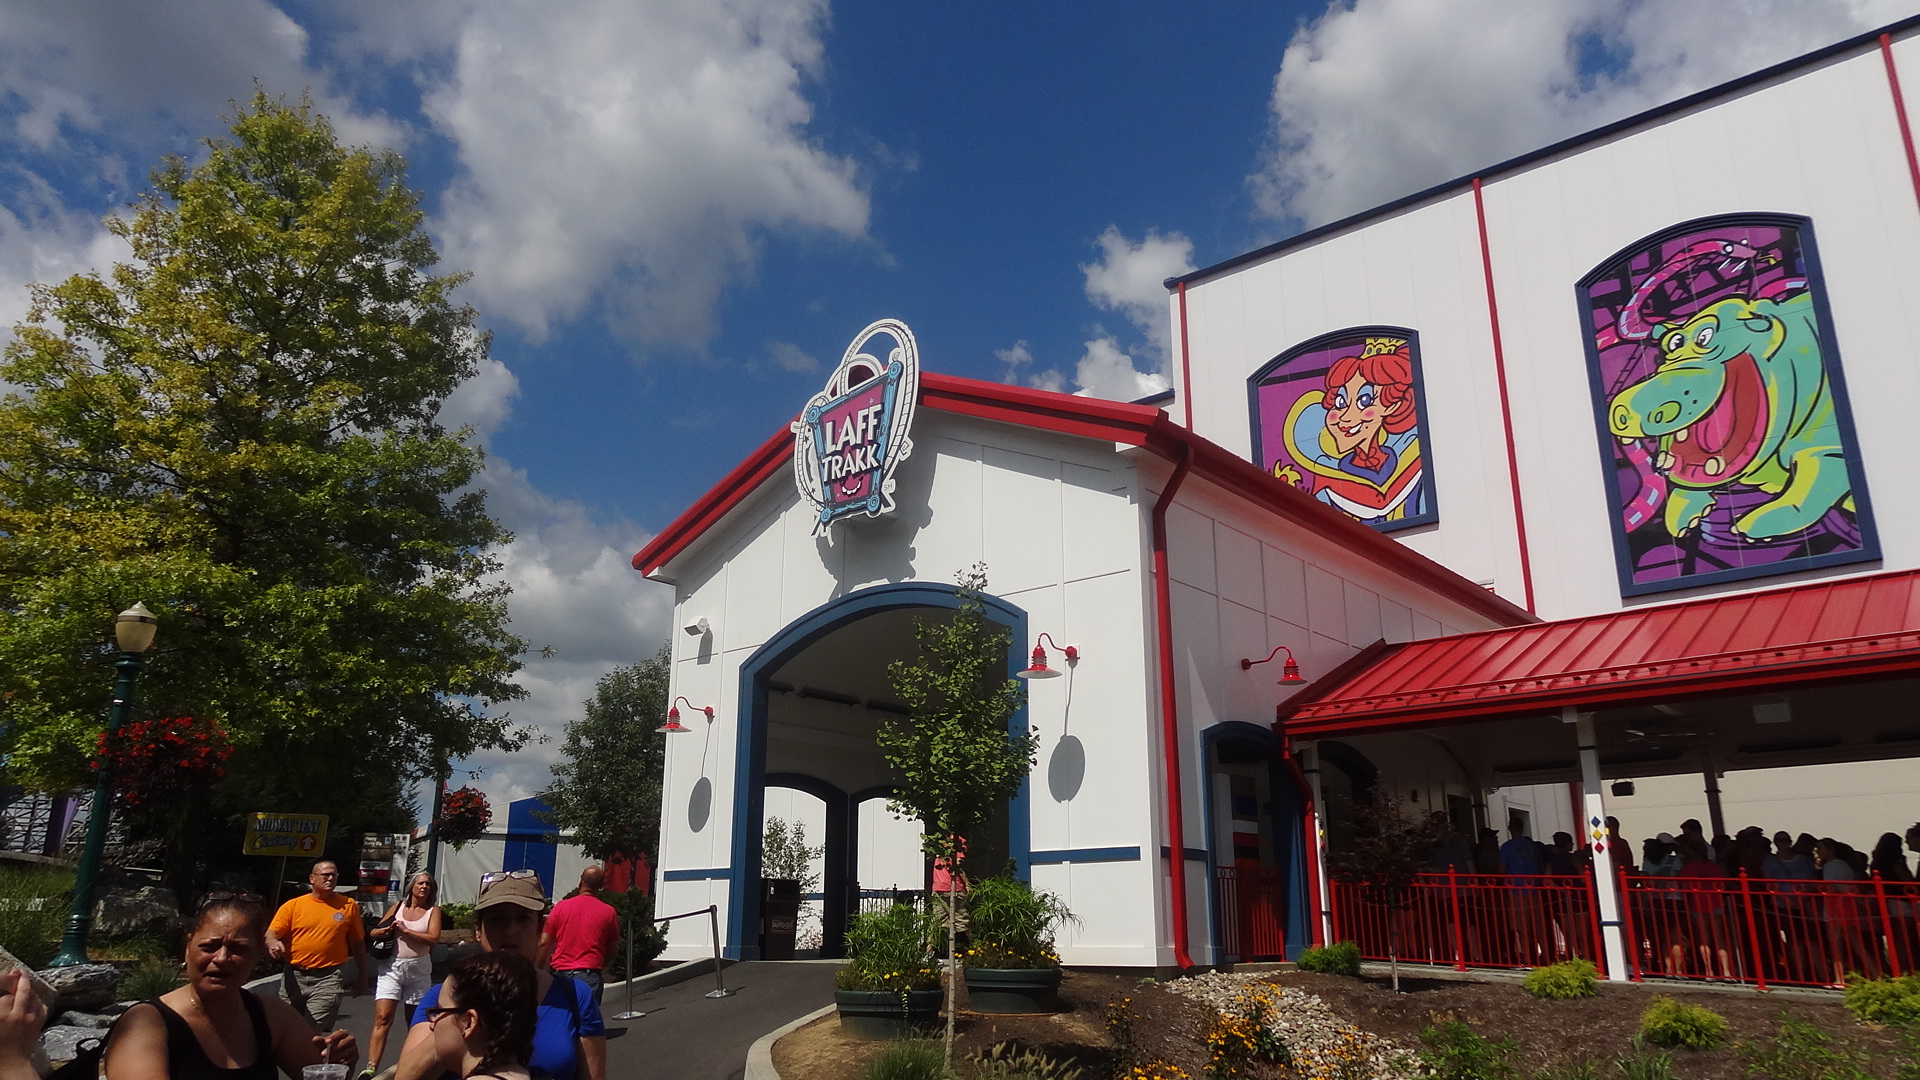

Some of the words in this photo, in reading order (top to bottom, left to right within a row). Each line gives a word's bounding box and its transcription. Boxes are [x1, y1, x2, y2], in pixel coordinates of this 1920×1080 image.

[826, 404, 883, 454] LAFF
[822, 443, 880, 482] TRAKK
[253, 818, 294, 832] MIDWAY
[296, 820, 320, 833] TENT
[252, 833, 298, 850] Catering
